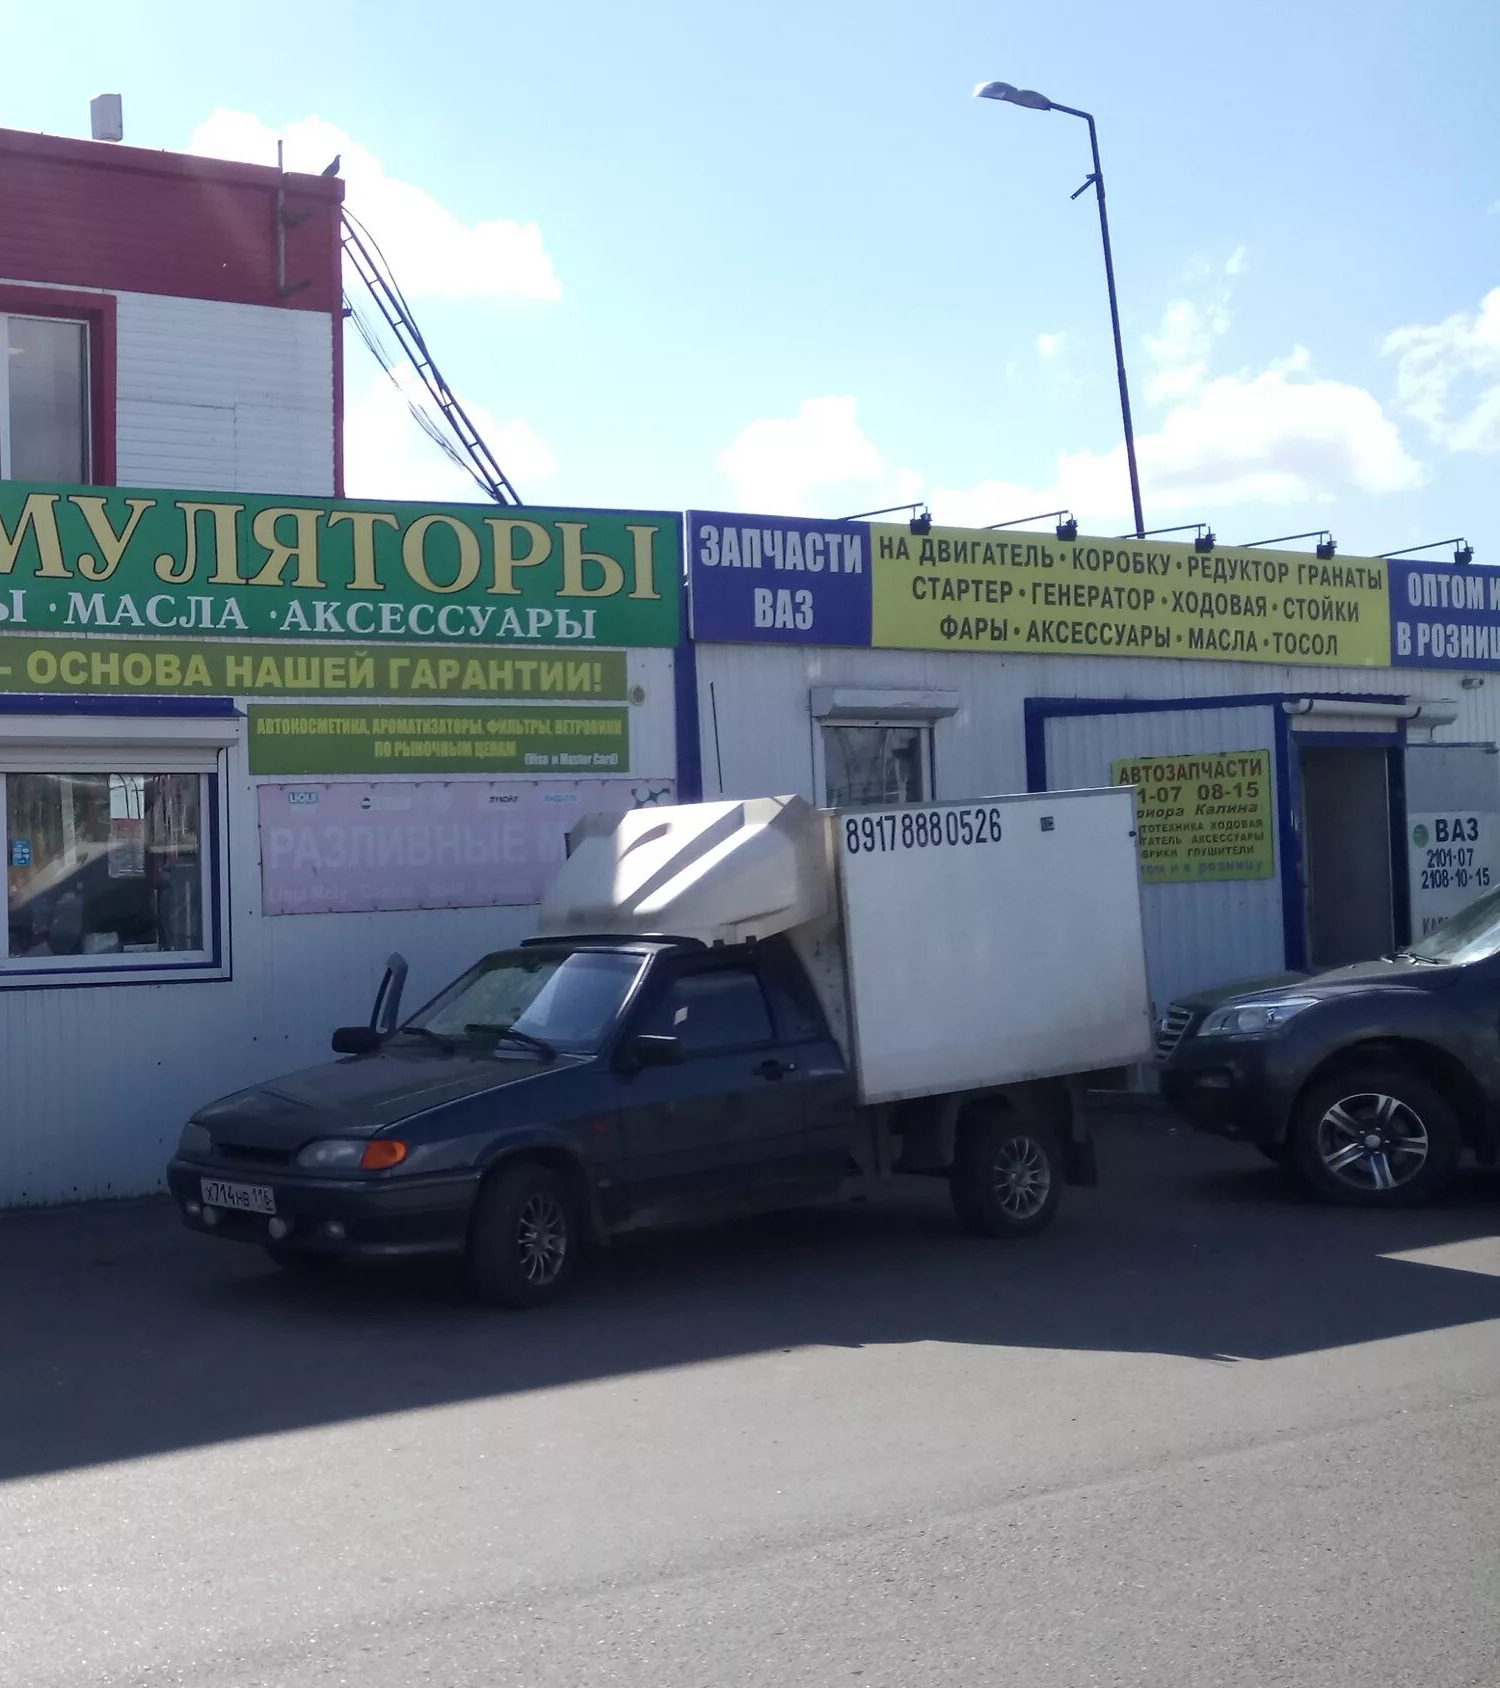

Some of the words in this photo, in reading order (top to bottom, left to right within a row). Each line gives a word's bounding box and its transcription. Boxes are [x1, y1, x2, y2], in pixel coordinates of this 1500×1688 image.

[699, 524, 863, 574] ЗАПЧАСТИ
[878, 535, 911, 561] НА
[919, 538, 1054, 569] ДВИГАТЕЛЬ
[1072, 547, 1171, 576] КОРОБКУ
[1187, 555, 1289, 584] РЕДУКТОР
[1298, 563, 1382, 590] ГРАНАТЫ
[912, 575, 1013, 604] СТАРТЕР
[1032, 581, 1155, 612] ГЕНЕРАТОР
[1171, 590, 1267, 619] ХОДОВАЯ
[1283, 595, 1359, 623] СТОЙКИ
[1407, 571, 1484, 610] ОПТОМ
[754, 587, 814, 631] ВАЗ
[939, 614, 1008, 642] ФАРЫ
[1026, 618, 1171, 649] АКСЕССУАРЫ
[1188, 626, 1257, 652] МАСЛА
[1274, 631, 1338, 656] ТОСОЛ
[1397, 621, 1412, 656] В
[26, 649, 206, 688] ОСНОВА
[225, 649, 375, 689] НАШЕЙ
[388, 657, 602, 692] ГАРАНТИИ!
[256, 718, 370, 735] АВТОКОСМЕТИКА,
[374, 741, 392, 758] ПО
[1118, 758, 1263, 786] АВТОЗАПЧАСТИ
[1196, 780, 1260, 803] 08-15
[1136, 806, 1185, 821] риора
[1194, 801, 1259, 818] Калина
[1191, 831, 1265, 846] АКСЕССУАРЫ
[1210, 819, 1264, 832] ХОДОВАЯ
[1434, 817, 1479, 843] ВАЗ
[269, 822, 526, 870] РАЗЛИВНЫЕ
[1187, 845, 1254, 858] ГЛУШИТЕЛИ
[1427, 847, 1475, 869] 2101-07
